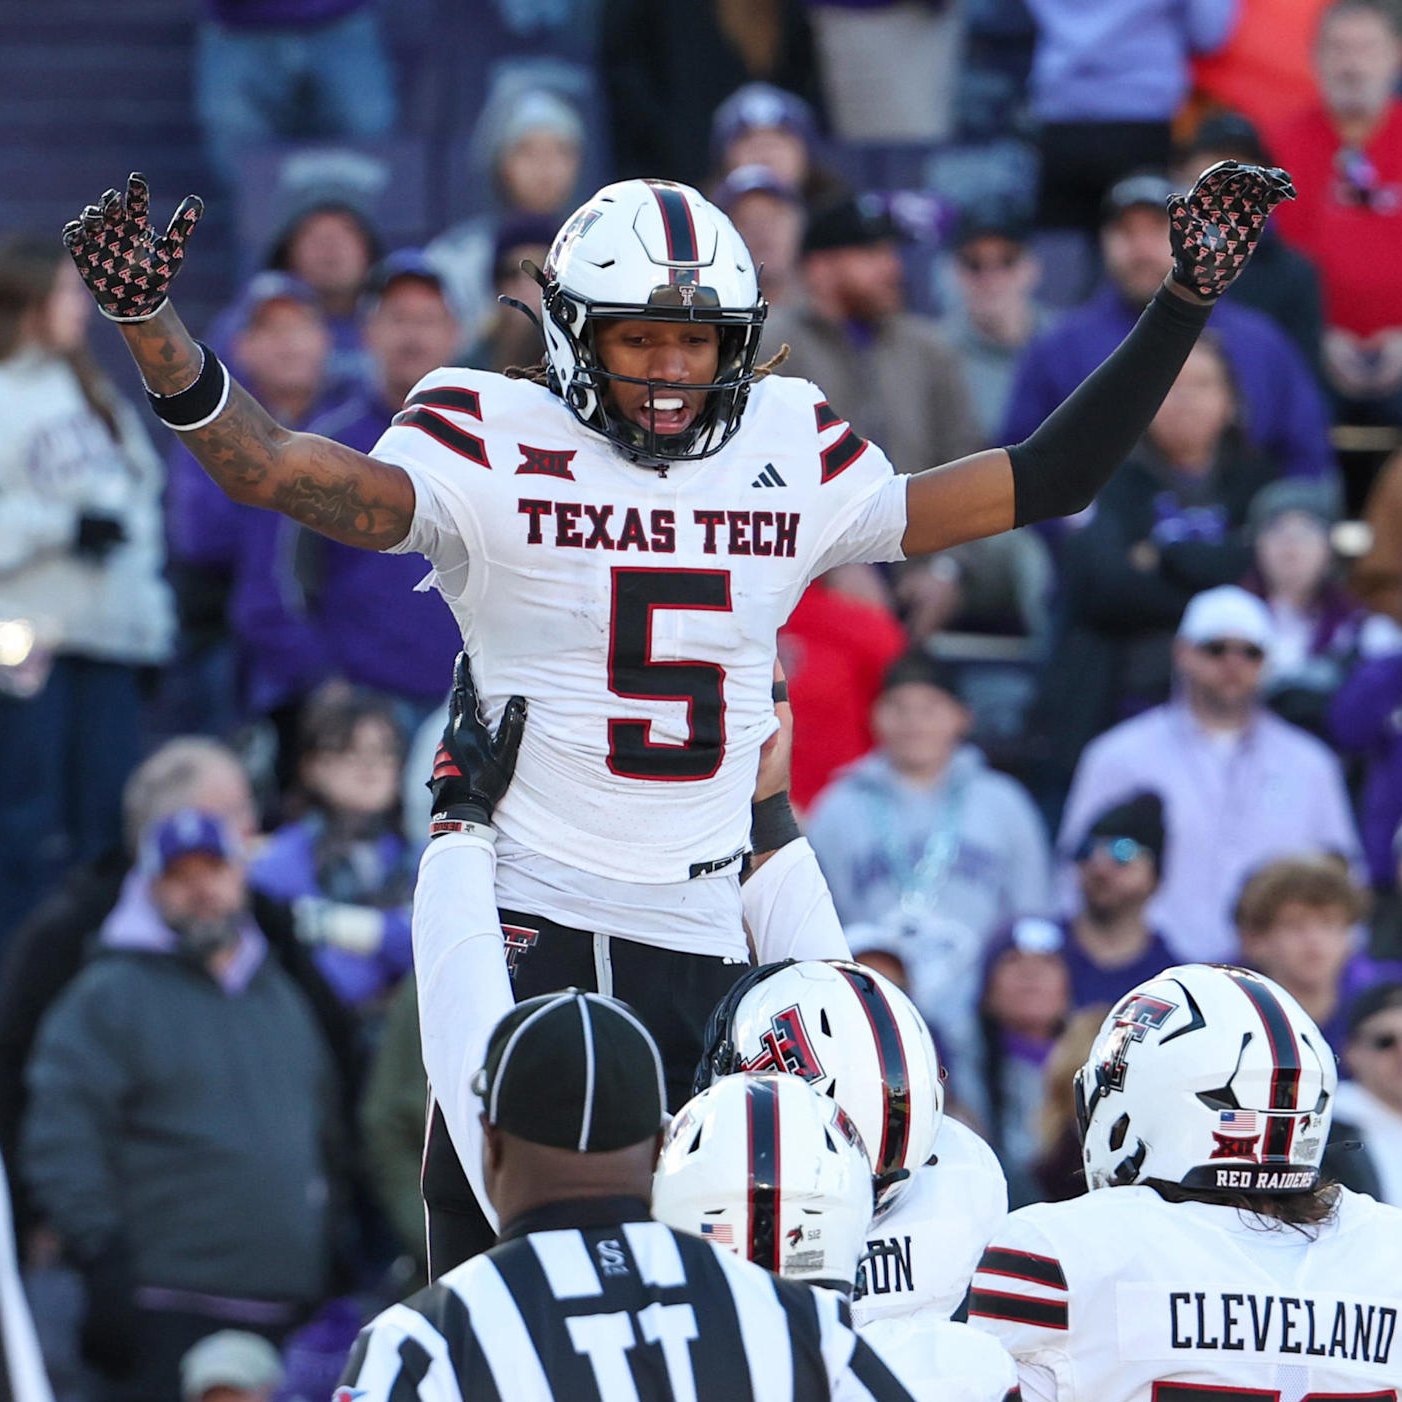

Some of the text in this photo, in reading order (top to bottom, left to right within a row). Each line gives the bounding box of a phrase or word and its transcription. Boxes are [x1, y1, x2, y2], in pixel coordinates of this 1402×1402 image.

[517, 498, 801, 558] TEXAS TECH
[605, 566, 733, 781] 5
[1216, 1169, 1315, 1189] RED RAIDERS
[1170, 1292, 1397, 1364] CLEVELAND
